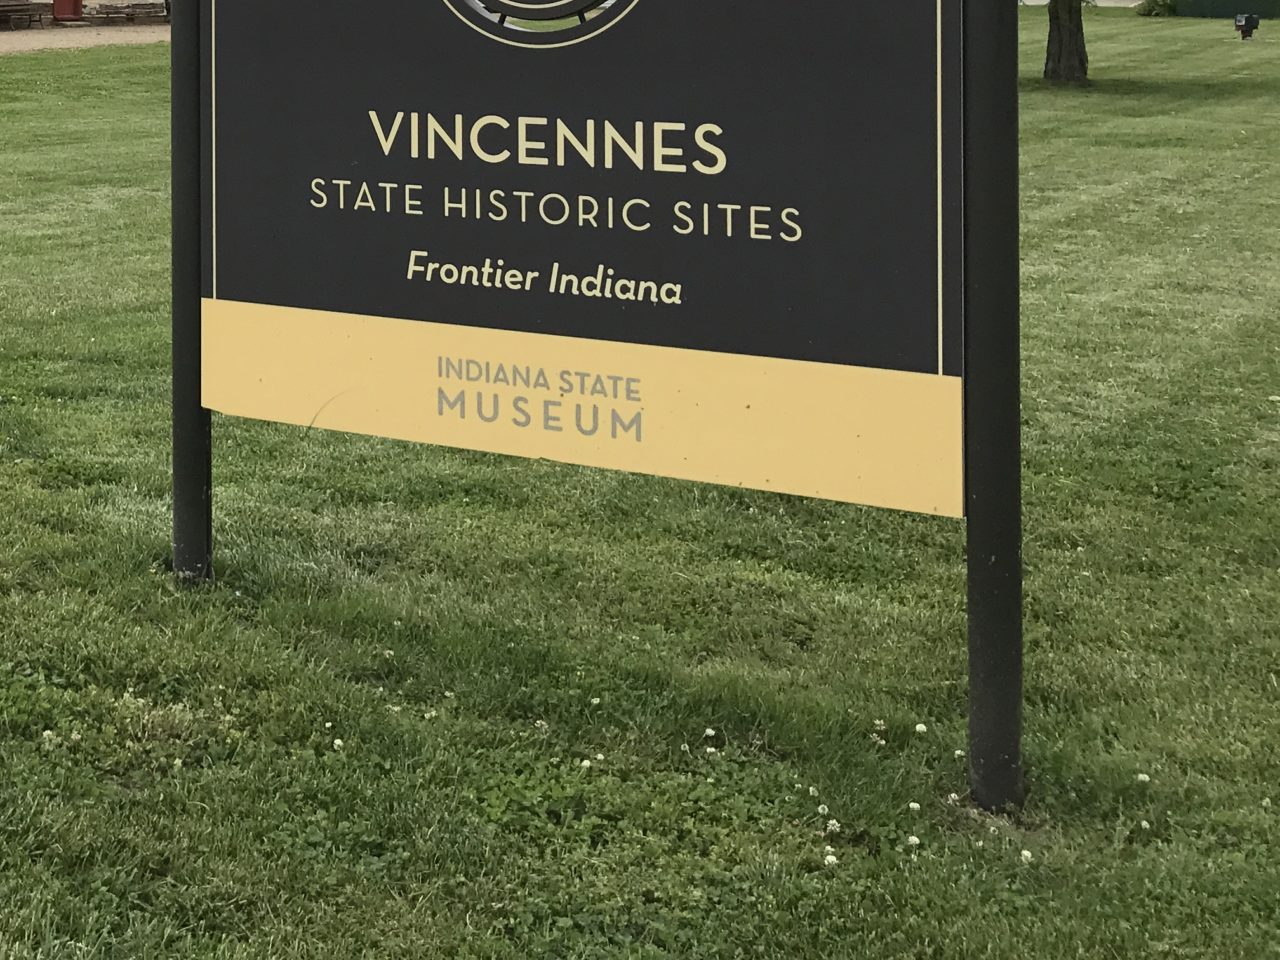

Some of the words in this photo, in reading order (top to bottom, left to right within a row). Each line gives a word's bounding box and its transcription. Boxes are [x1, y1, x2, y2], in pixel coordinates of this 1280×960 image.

[369, 111, 726, 174] VINCENNES
[311, 178, 423, 215] STATE
[444, 187, 651, 231] HISTORIC
[673, 201, 802, 242] SITES
[407, 250, 539, 290] Frontier
[549, 263, 682, 305] Indiana
[437, 356, 551, 391] INDIANA
[558, 369, 642, 402] STATE
[437, 387, 643, 443] MUSEUM
